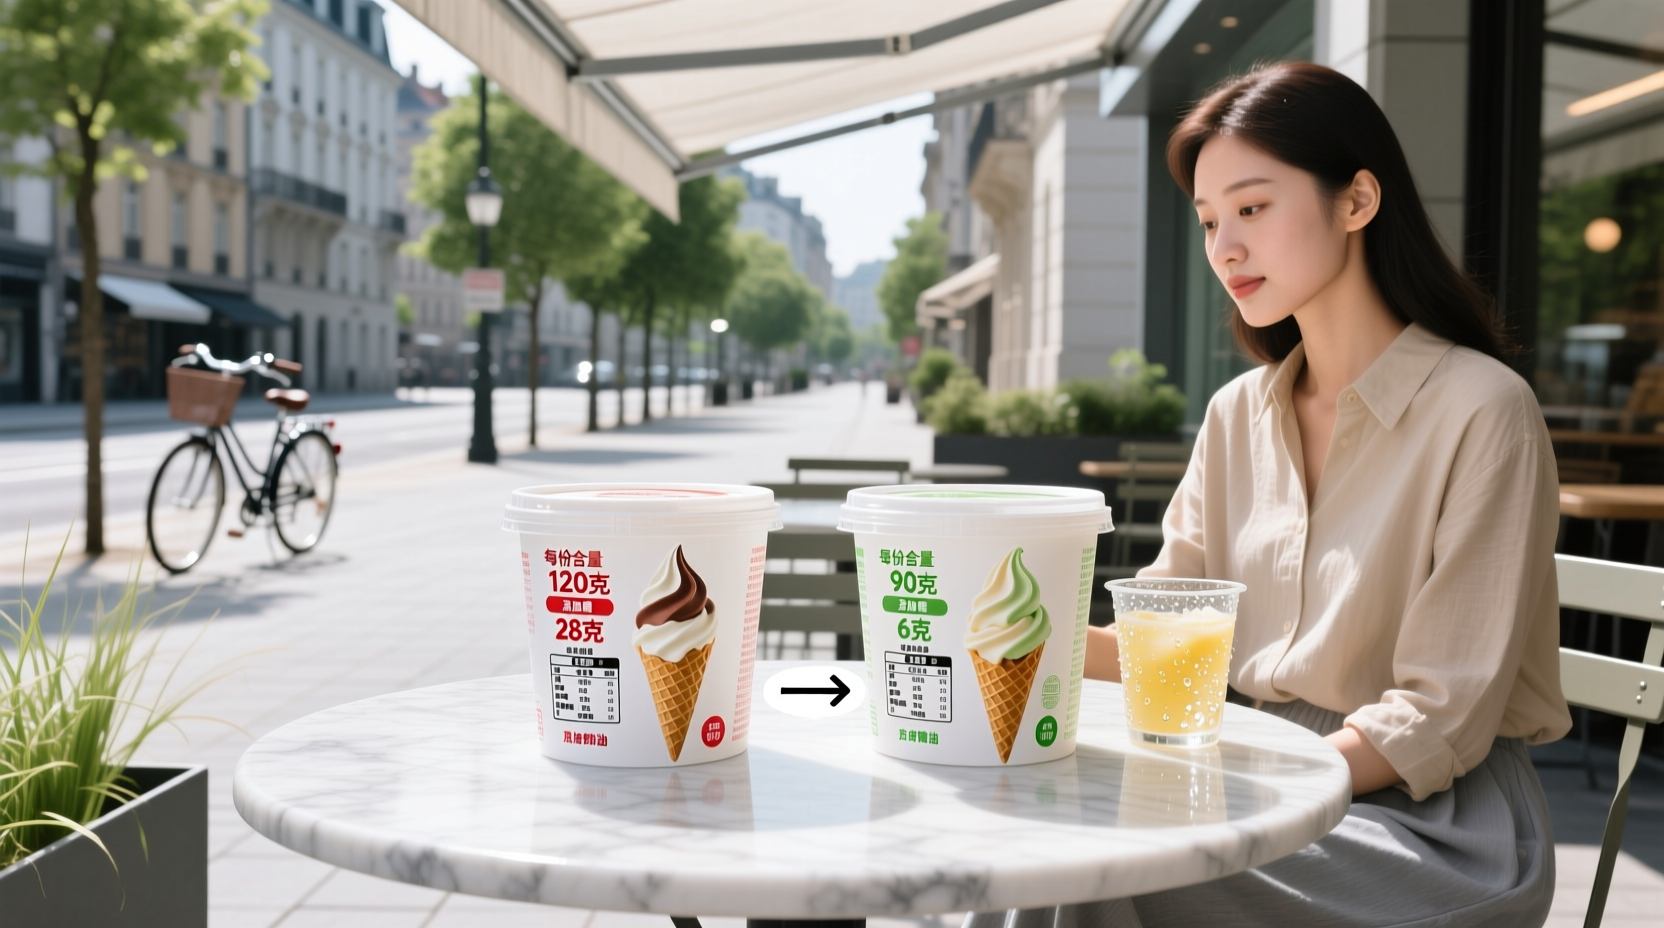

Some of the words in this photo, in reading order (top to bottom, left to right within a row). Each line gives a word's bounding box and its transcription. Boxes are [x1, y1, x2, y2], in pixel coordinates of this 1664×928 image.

[548, 570, 610, 595] 120克
[890, 570, 938, 595] 90克
[555, 618, 604, 643] 28克
[897, 617, 932, 642] 6克
